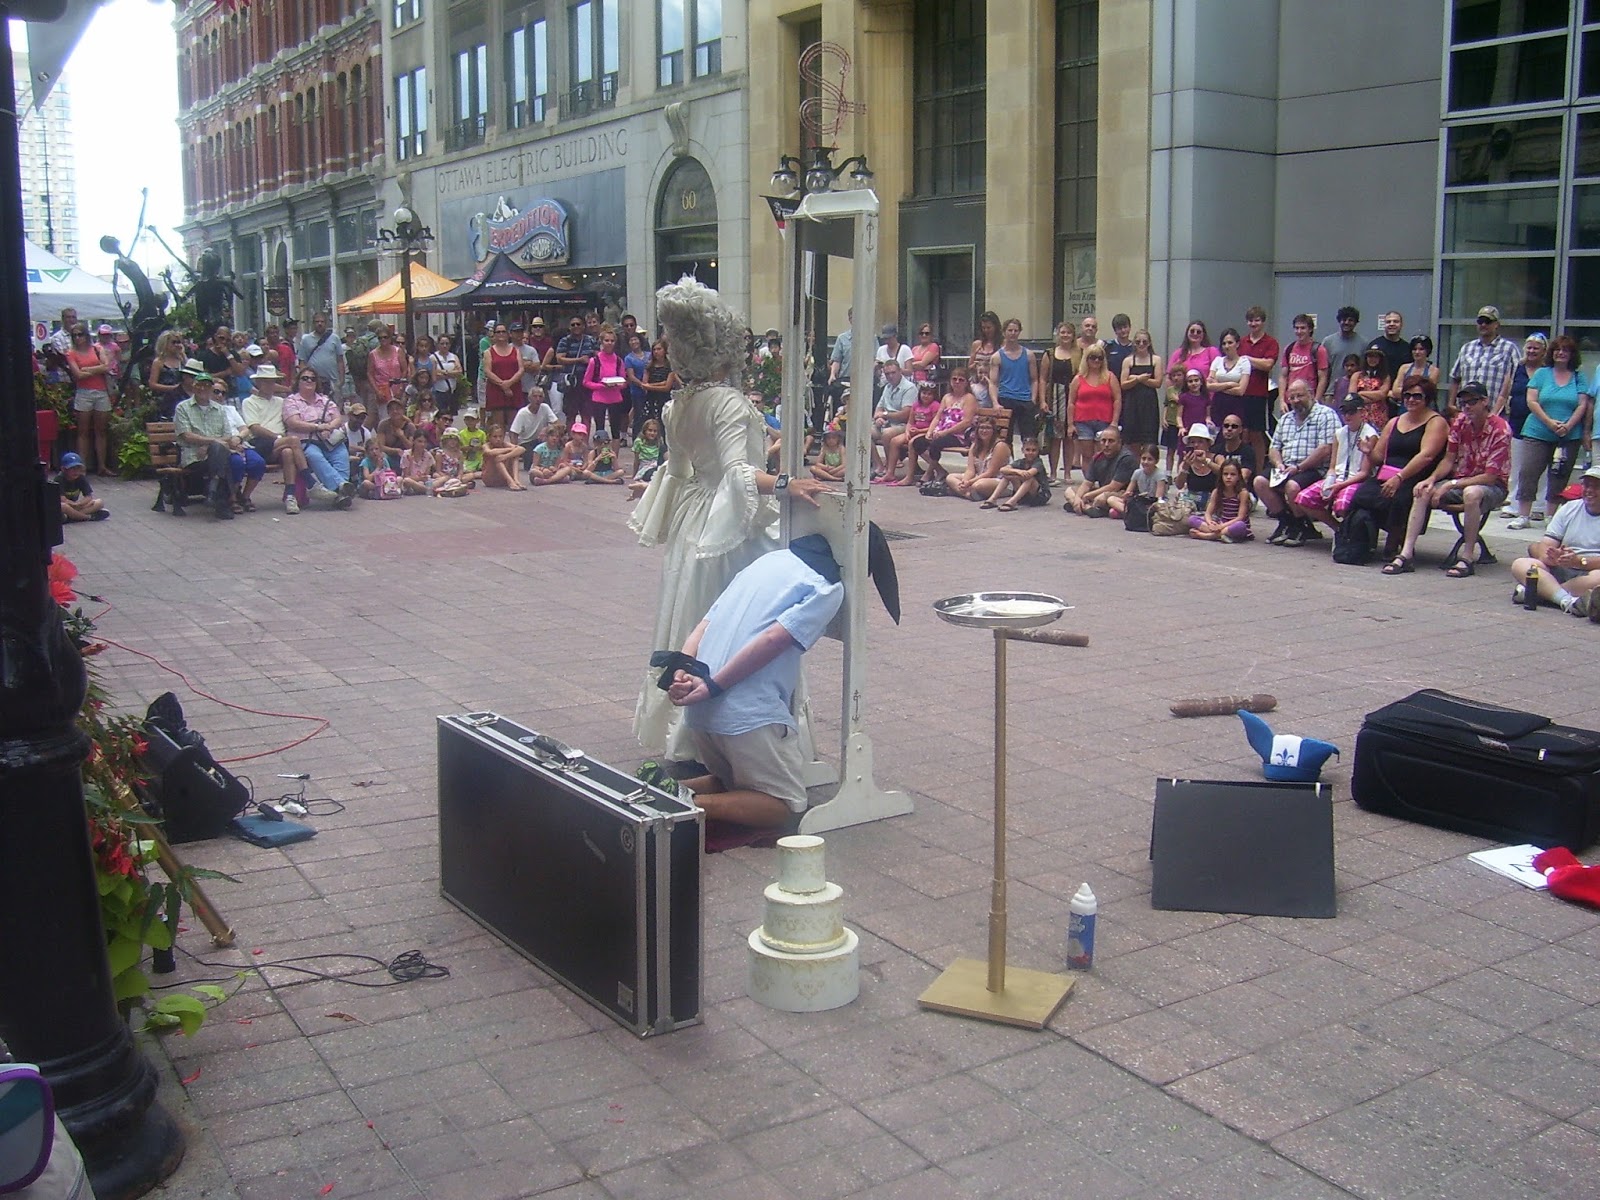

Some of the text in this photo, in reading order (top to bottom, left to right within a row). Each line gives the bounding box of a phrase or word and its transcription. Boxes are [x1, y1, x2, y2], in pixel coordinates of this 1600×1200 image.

[438, 128, 628, 194] OTTAWA ELECTRIC BUILDING
[682, 190, 696, 210] 60
[489, 203, 561, 250] EXPEDITION
[485, 279, 548, 290] RYDERS
